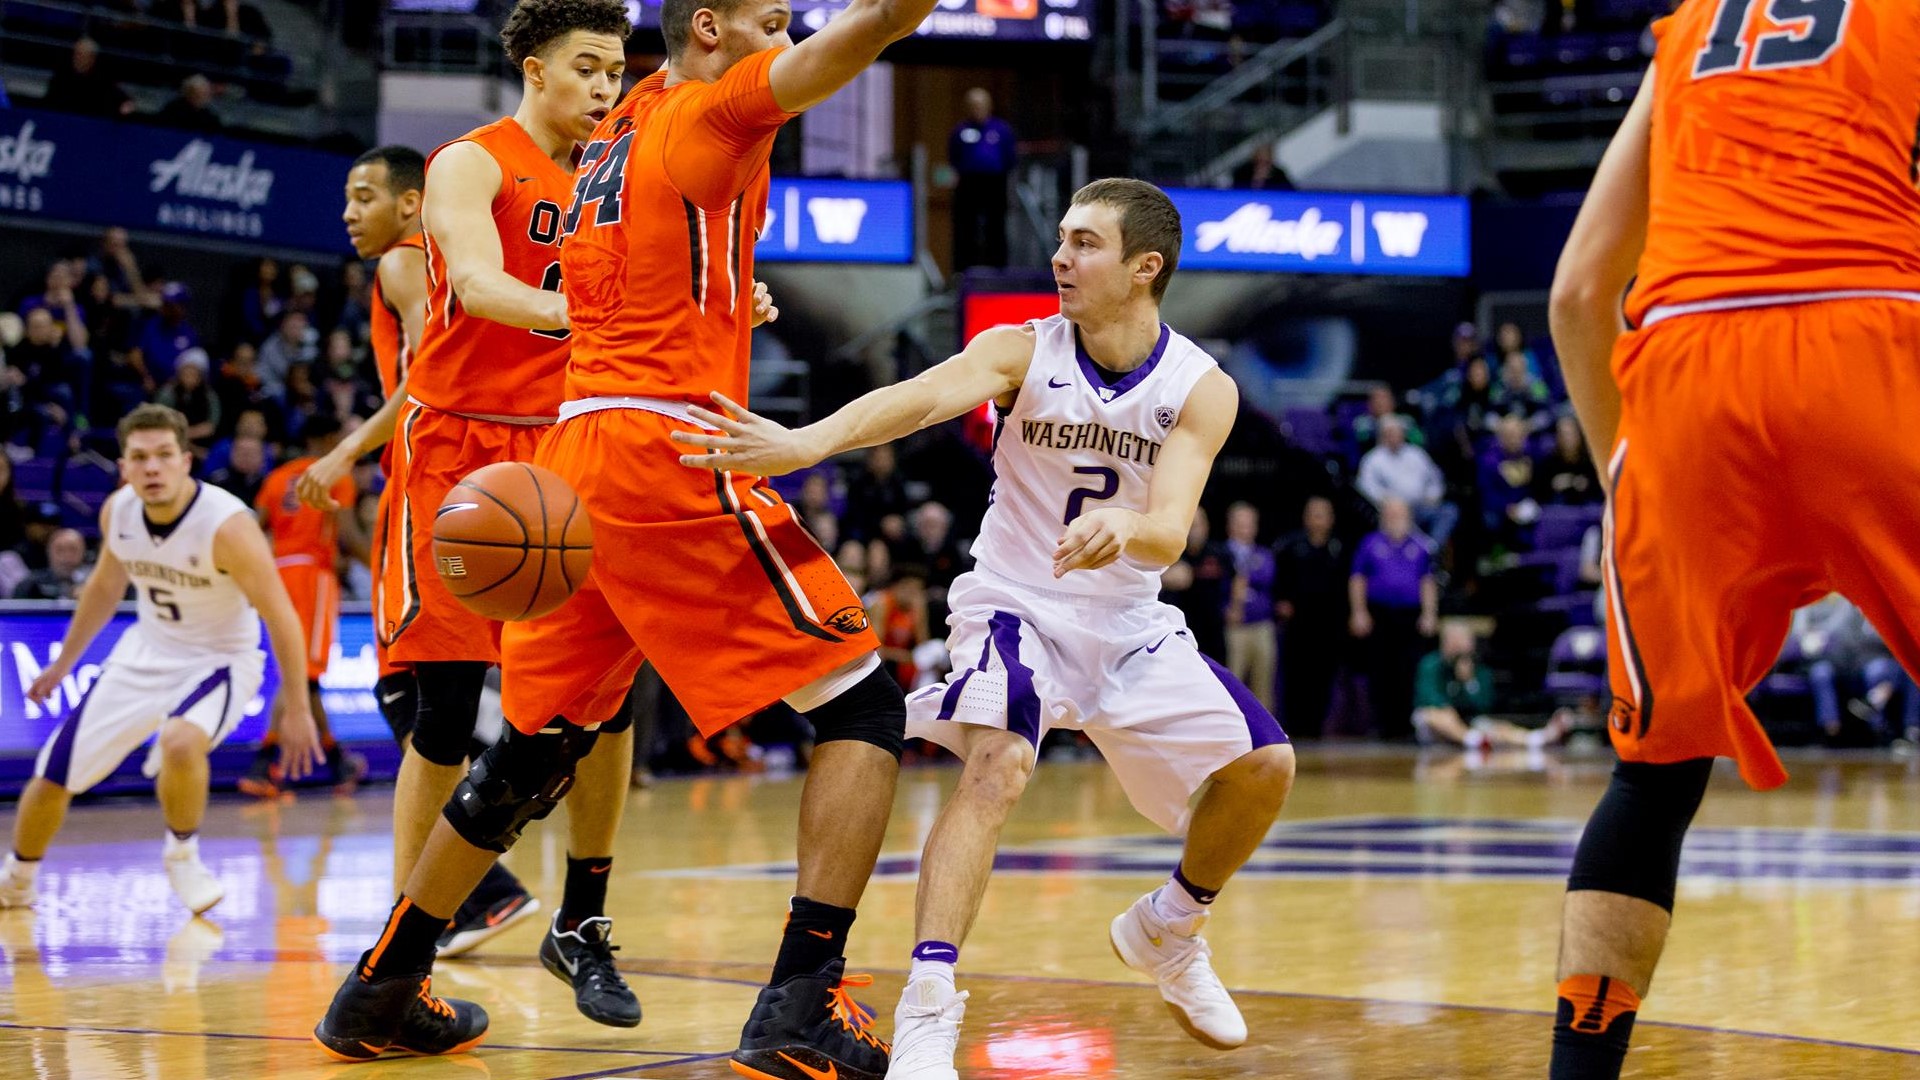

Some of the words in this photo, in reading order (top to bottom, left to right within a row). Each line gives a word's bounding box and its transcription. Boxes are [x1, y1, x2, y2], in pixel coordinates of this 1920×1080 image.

[1690, 0, 1852, 79] 15
[150, 139, 274, 209] Alaska
[563, 130, 636, 237] 34
[1194, 202, 1344, 261] Alaska
[1022, 419, 1161, 466] WASHINGTO
[1063, 466, 1119, 526] 2
[121, 561, 212, 588] ASHINGTON
[148, 585, 181, 621] 5
